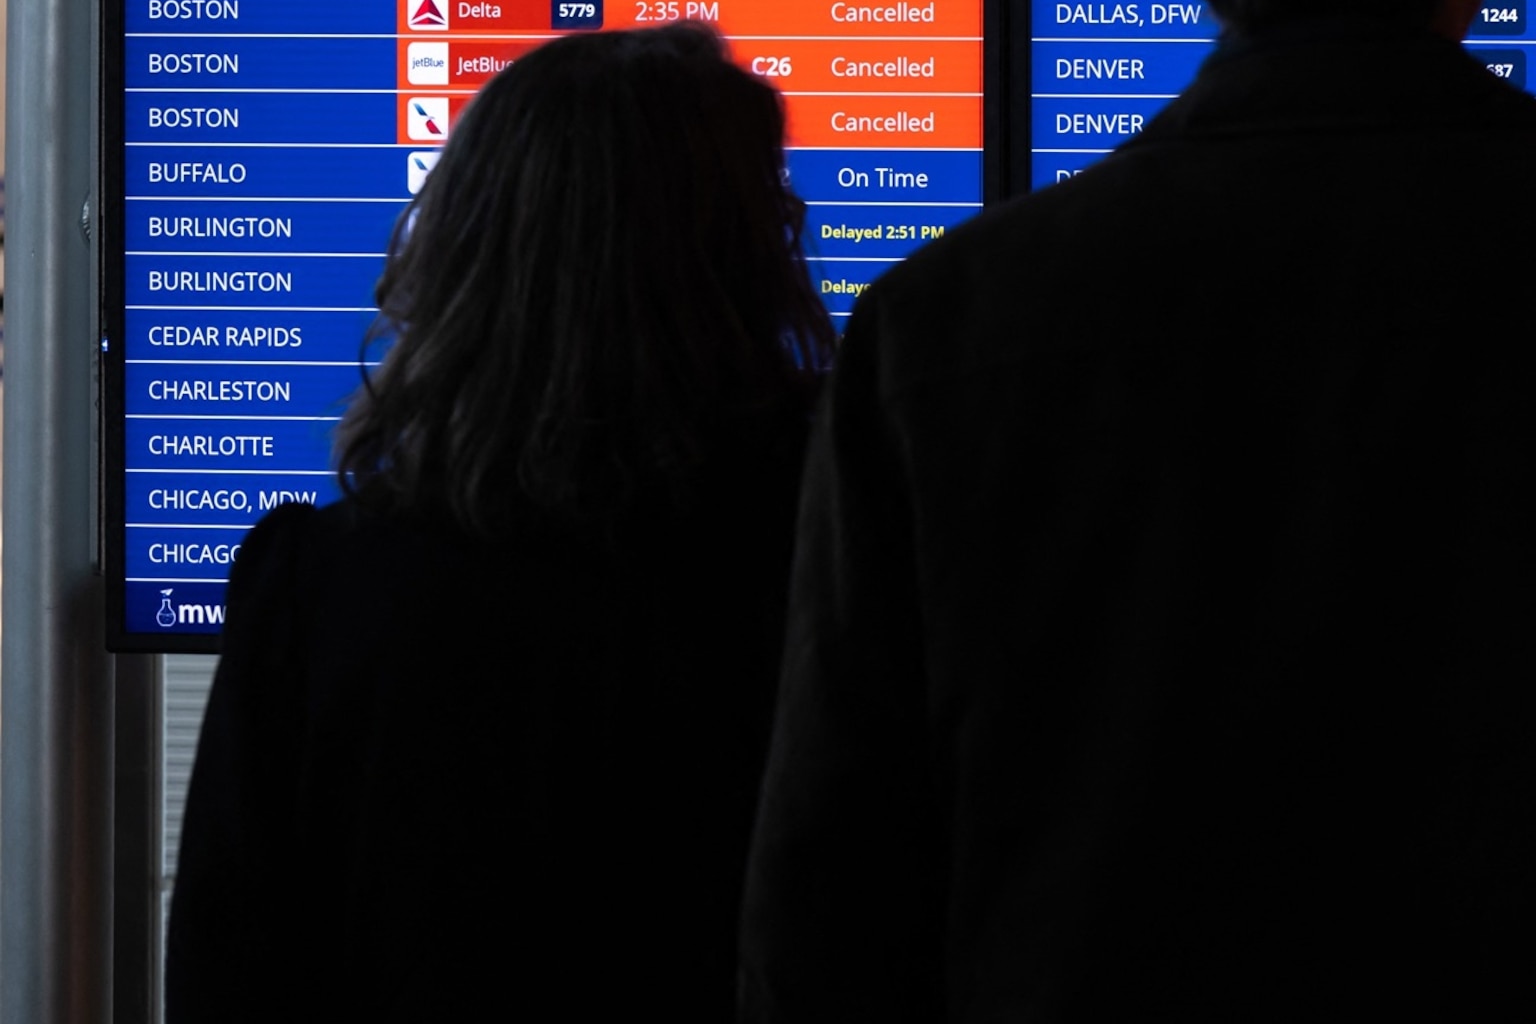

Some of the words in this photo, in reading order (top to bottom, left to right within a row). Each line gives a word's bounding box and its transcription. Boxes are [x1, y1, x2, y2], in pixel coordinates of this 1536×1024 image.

[1056, 3, 1144, 27] DALLAS,
[1151, 3, 1202, 24] DFW
[1481, 8, 1518, 23] 1244
[1056, 59, 1144, 80] DENVER
[149, 216, 292, 238] BURLINGTON
[148, 326, 220, 346] CEDAR
[225, 326, 302, 347] RAPIDS
[148, 380, 290, 402] CHARLESTON
